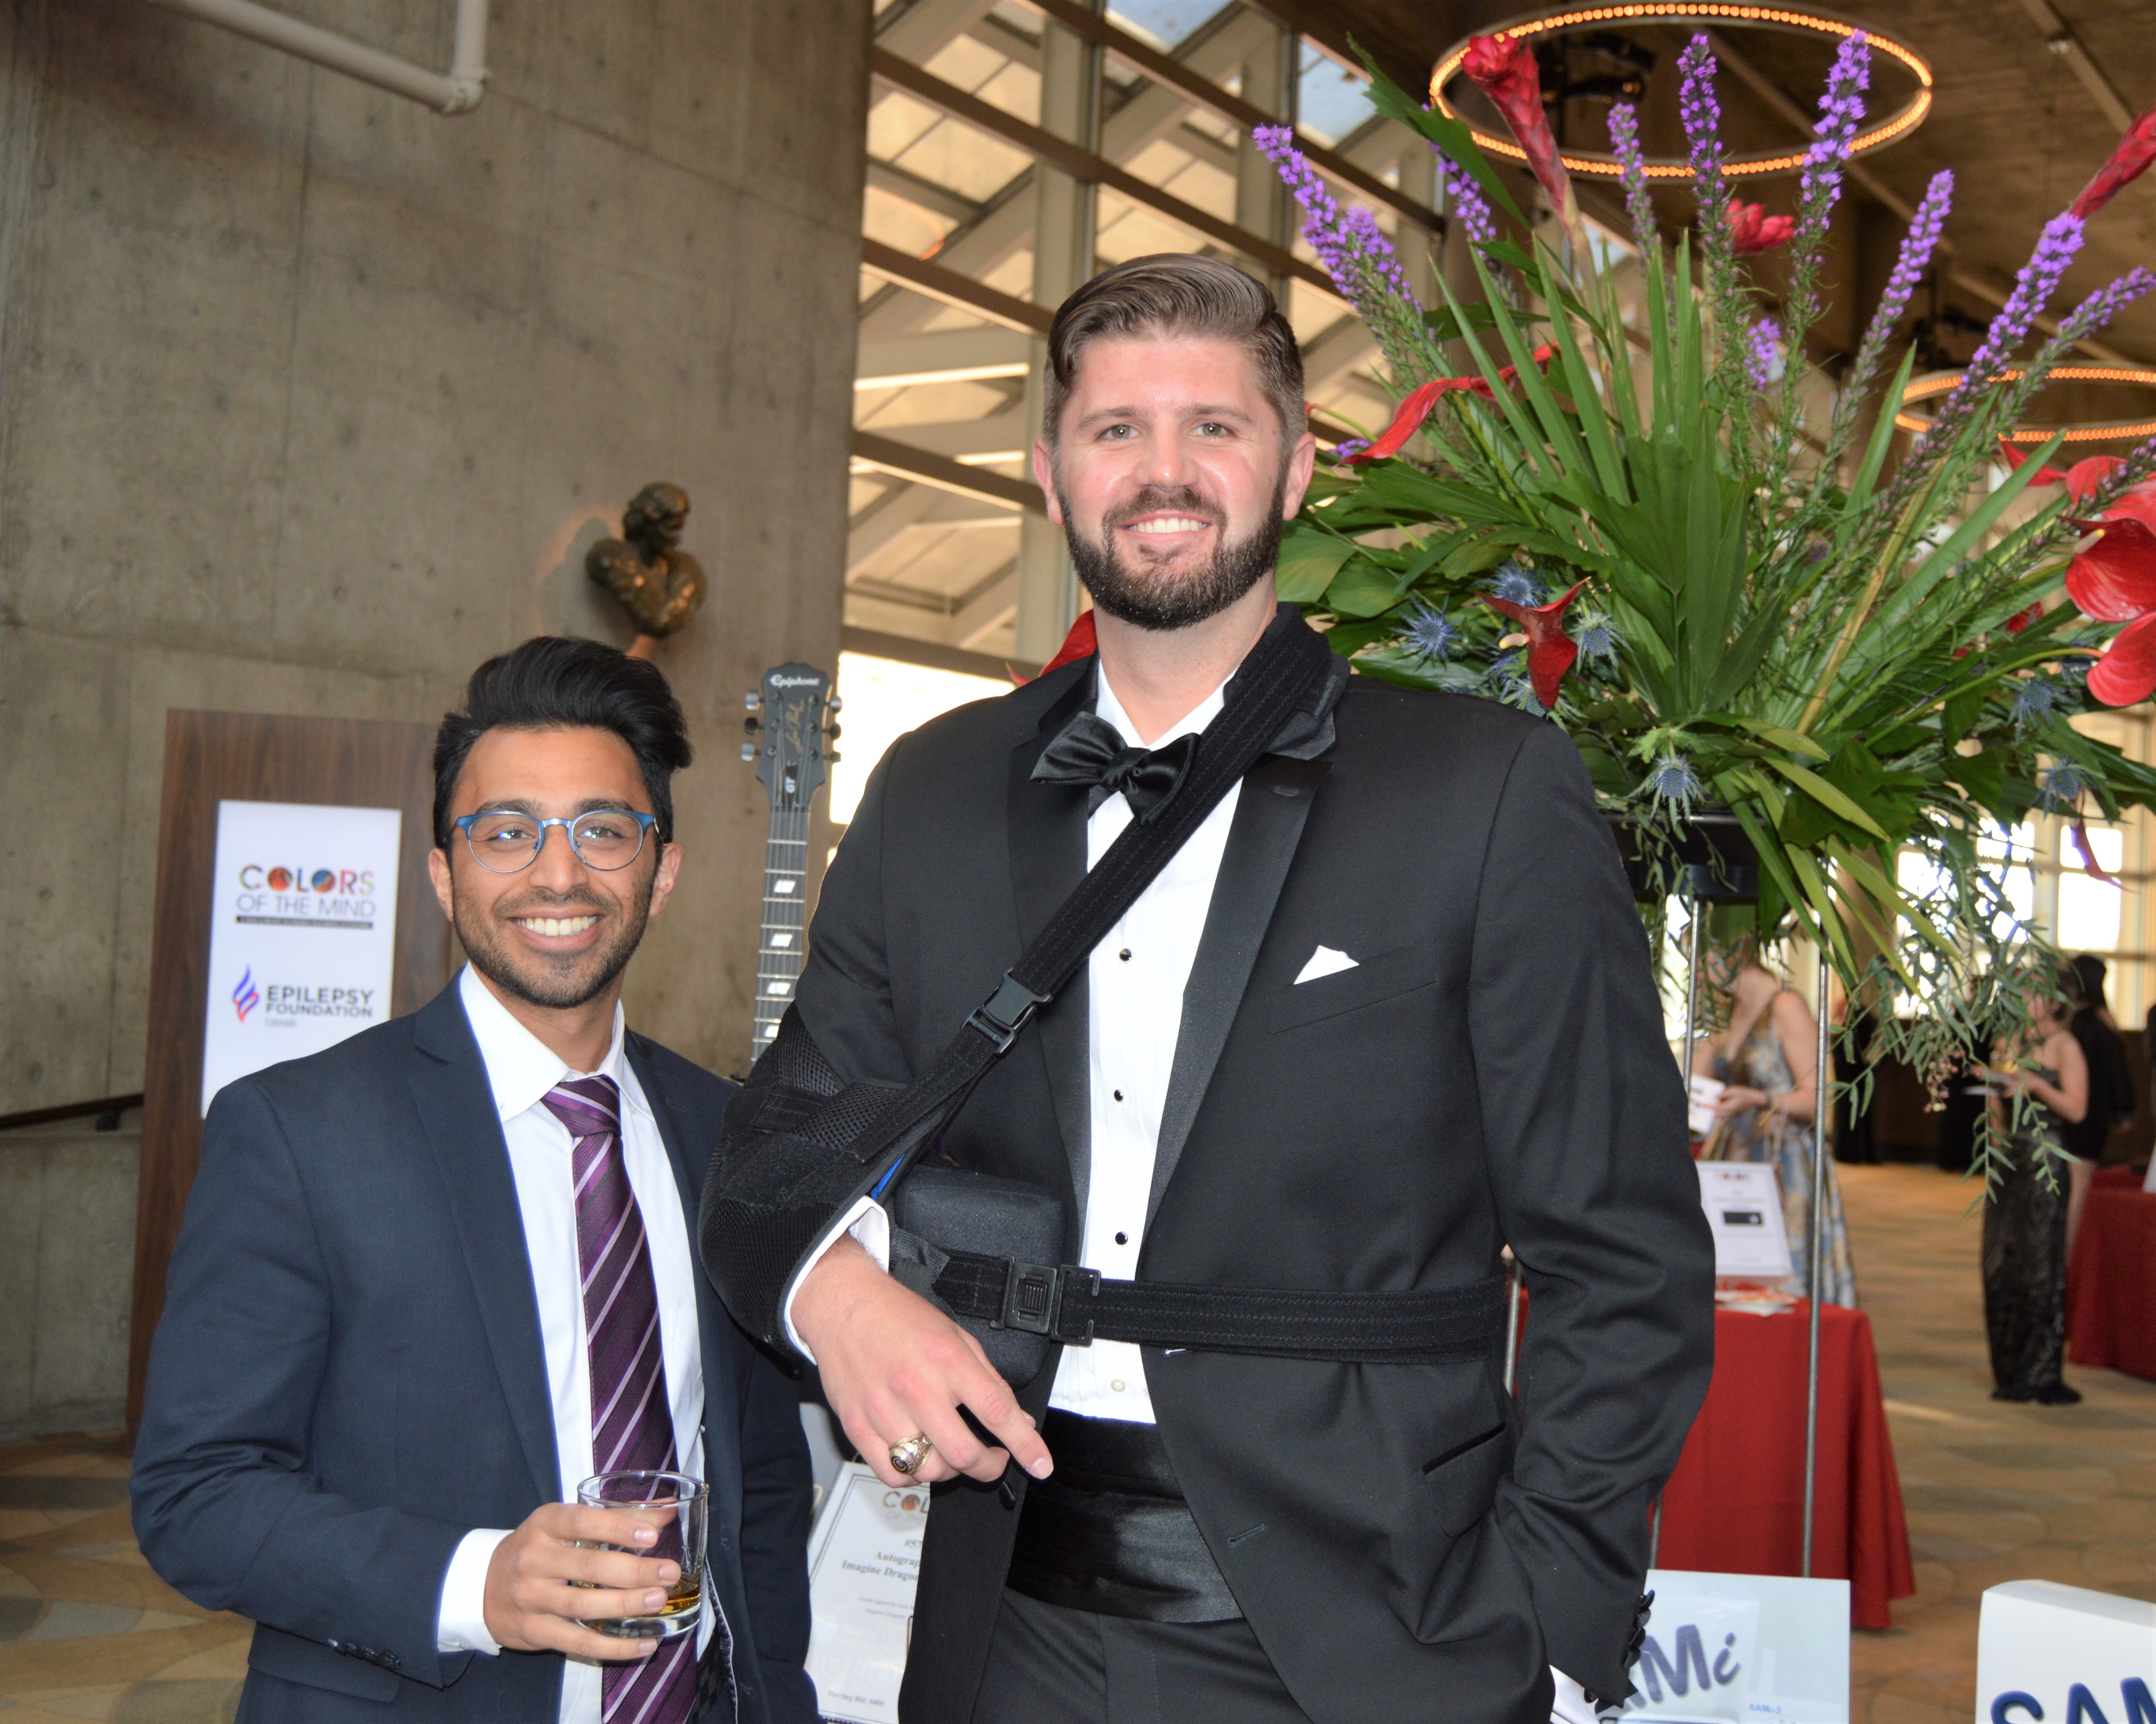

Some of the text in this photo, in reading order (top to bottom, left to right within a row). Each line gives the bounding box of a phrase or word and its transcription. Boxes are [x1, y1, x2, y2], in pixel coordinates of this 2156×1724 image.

[239, 865, 375, 895] COLORS
[237, 893, 376, 919] OF THE MIND
[267, 985, 374, 1005] EPILEPSY
[266, 1003, 373, 1017] FOUNDATION
[841, 1560, 882, 1575] Imagine
